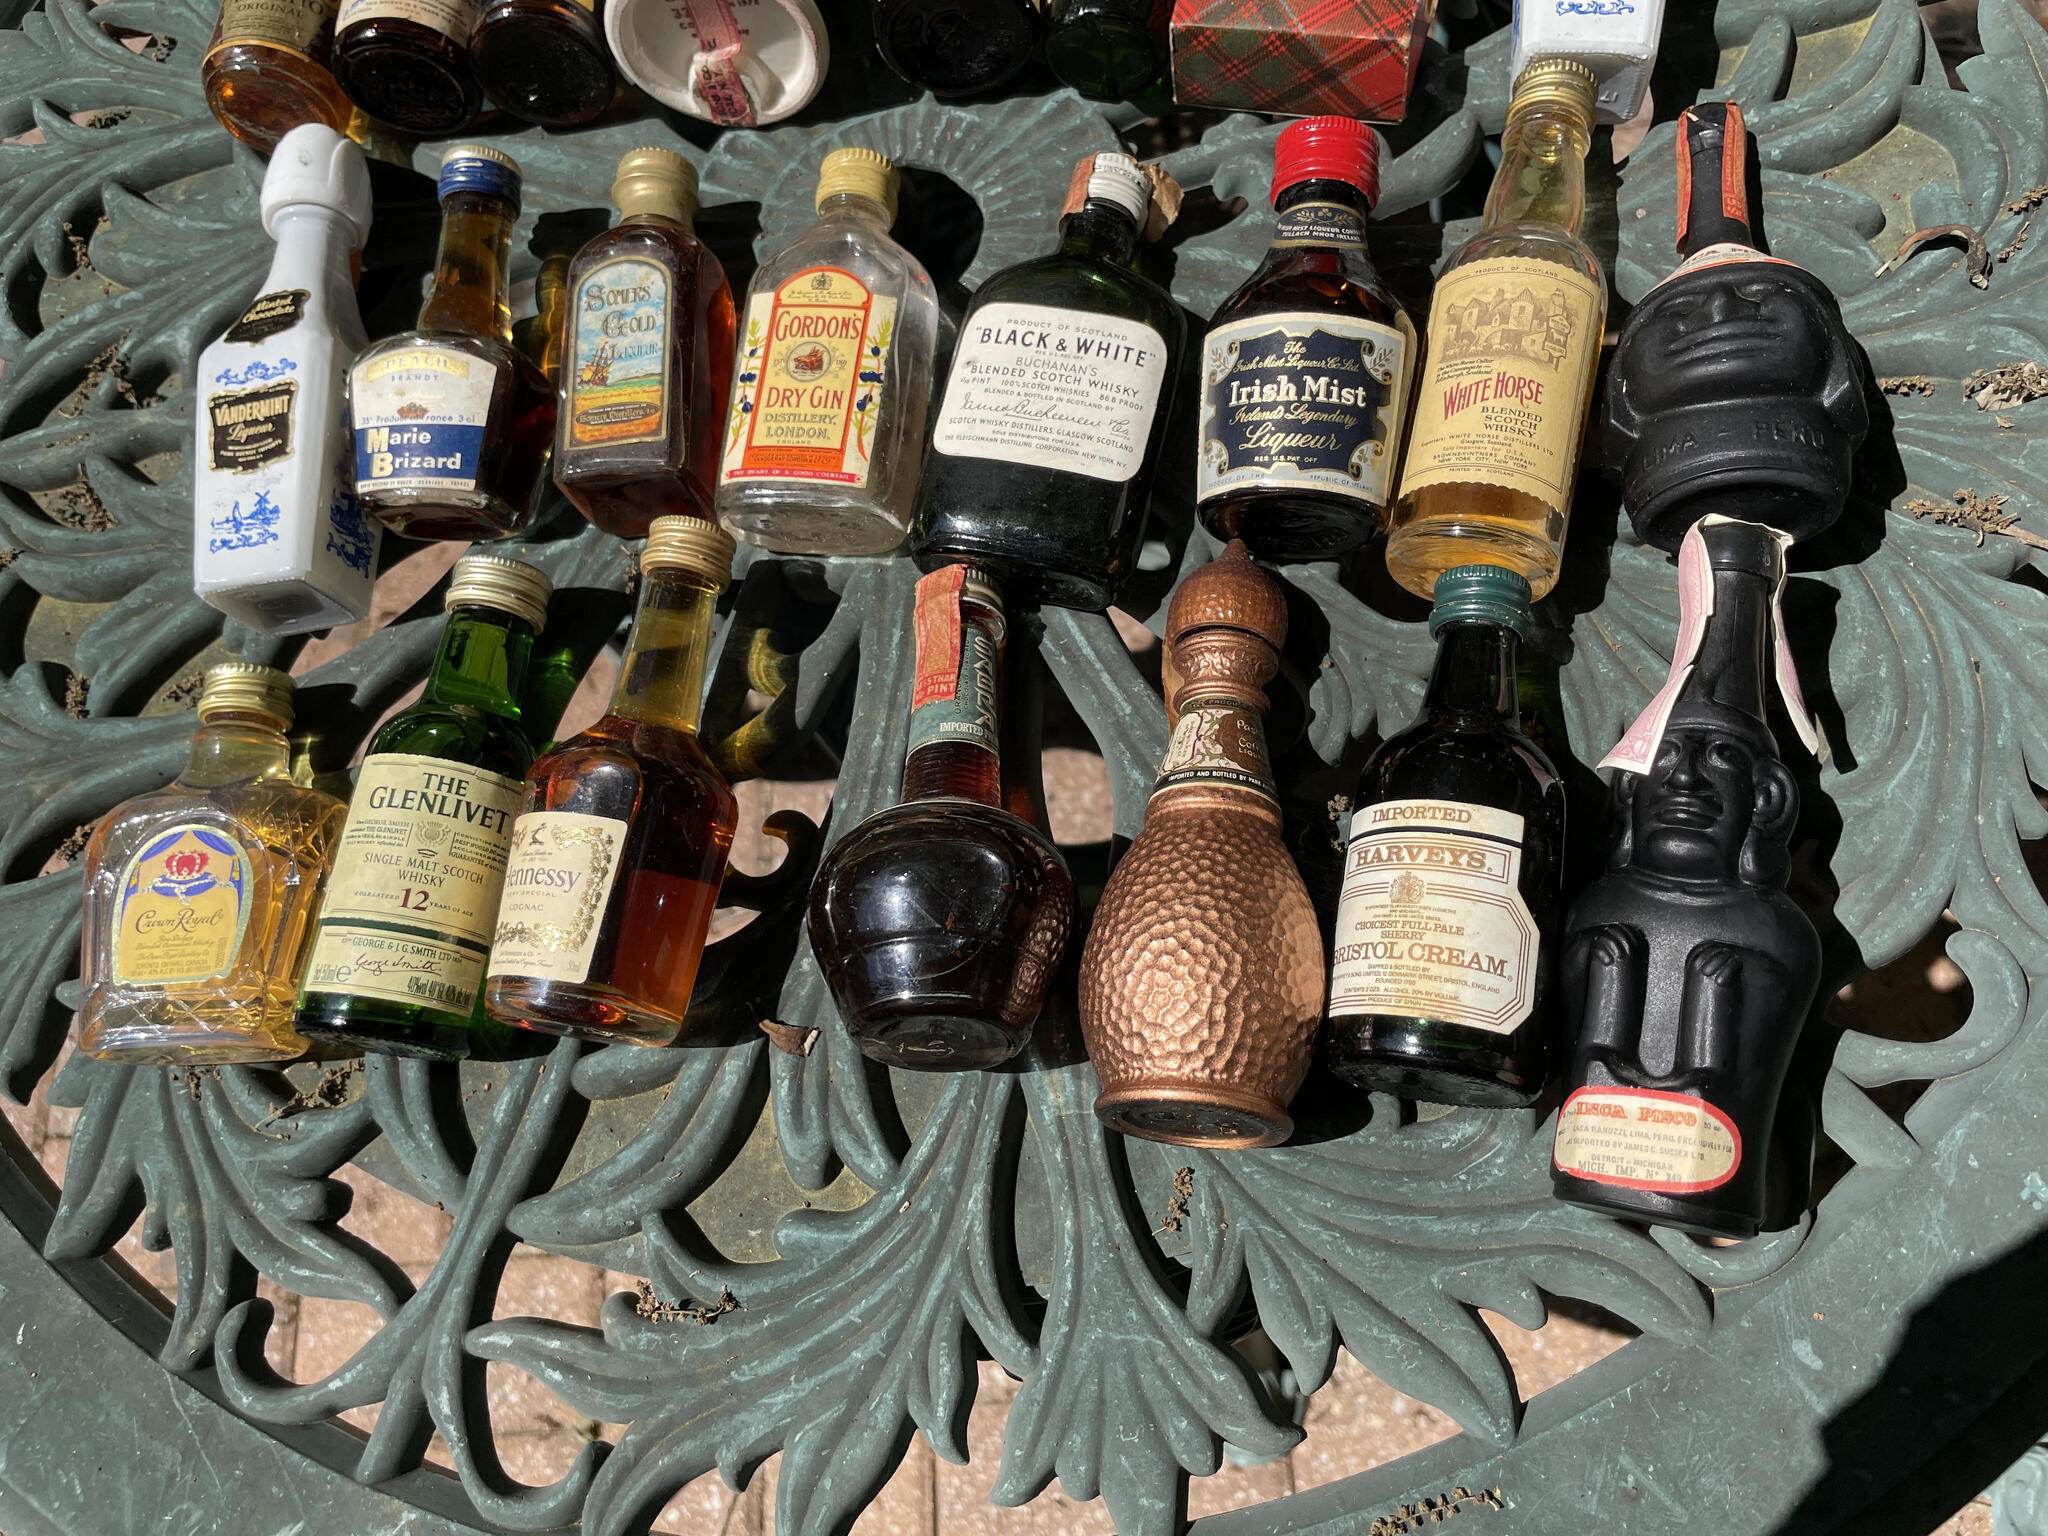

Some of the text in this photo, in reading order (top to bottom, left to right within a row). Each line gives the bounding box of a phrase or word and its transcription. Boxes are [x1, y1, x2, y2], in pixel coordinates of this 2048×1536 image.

[239, 2, 303, 17] ORIGINAL
[1309, 225, 1340, 233] LIQUEUR
[1475, 266, 1504, 274] PRODUCT
[1525, 267, 1558, 277] SCOTLAND
[603, 310, 656, 339] GOLD
[775, 310, 862, 341] GORDON'S
[1007, 319, 1052, 329] PRODUCT
[1075, 327, 1128, 342] SCOTLAND
[1056, 338, 1067, 352] &
[1283, 341, 1307, 354] The
[386, 356, 448, 369] PEACH
[1016, 356, 1098, 377] BUCHANAN'S
[1232, 354, 1327, 373] Irish Mist Liqueur
[391, 374, 440, 383] BRANDY
[971, 365, 1140, 398] BLENDED SCOTCH WHISKY
[765, 386, 844, 410] DRY GIN
[984, 388, 1015, 396] BLENDED
[1024, 390, 1054, 401] BOTTLED
[1066, 398, 1103, 410] SCOTLAND
[1022, 383, 1051, 392] SCOTCH
[1054, 386, 1090, 398] WHISKIES
[1119, 399, 1144, 412] PROOF
[1228, 374, 1367, 408] Irish Mist
[1443, 371, 1544, 421] WHITE HORSE
[215, 395, 290, 427] VANDERMINT
[458, 414, 476, 424] 3 cl
[1284, 402, 1359, 430] Legendary
[1481, 405, 1543, 423] BLENDED
[1484, 415, 1538, 431] SCOTCH
[1484, 423, 1537, 439] WHISKY
[366, 427, 432, 454] Marie
[948, 417, 977, 425] SCOTCH
[979, 418, 1009, 428] WHISKY
[1096, 437, 1134, 454] SCOTLAND
[1239, 421, 1342, 455] Liqueur
[1000, 438, 1033, 448] DISTILLING
[1035, 443, 1079, 456] CORPORATION
[1082, 451, 1097, 460] NEW
[1503, 436, 1540, 450] DISTILLERS
[1543, 447, 1554, 456] LTD
[371, 451, 462, 479] Brizard
[1504, 454, 1537, 468] COMPANY
[1512, 462, 1528, 470] YORK
[1310, 474, 1339, 485] REPUBLIC
[1486, 468, 1515, 477] SCOTLAND
[928, 673, 957, 685] THAN
[927, 682, 957, 695] PINT
[939, 721, 984, 736] IMPORTED
[422, 771, 470, 798] THE
[1168, 771, 1195, 782] IMPORTED
[1212, 771, 1237, 780] BOTTLED
[1239, 774, 1247, 782] BY
[1371, 806, 1472, 825] IMPORTED
[363, 852, 485, 885] SINGLE MALT SCOTCH
[398, 869, 447, 889] WHISKY
[399, 887, 431, 912] 12
[430, 901, 452, 911] YEARS
[462, 910, 474, 918] AGE
[520, 890, 557, 898] SPECIAL
[508, 903, 544, 912] COGNAC
[135, 907, 221, 935] Crown Royal
[1355, 920, 1465, 937] CHOICEST FULL PALE
[1380, 930, 1427, 941] SHERRY
[352, 937, 452, 961] GEORGE & SMITH LTD
[353, 953, 390, 976] George
[1394, 964, 1421, 972] BOTTLED
[1408, 942, 1508, 979] CREAM
[1375, 977, 1403, 985] FOUNDED
[1471, 981, 1500, 994] ENGLAND
[1367, 996, 1422, 1007] PRODUCE SPAIN
[1434, 991, 1460, 1000] VOLUME
[1576, 1101, 1629, 1119] INCA
[1637, 1107, 1697, 1127] PISCO
[1612, 1141, 1623, 1149] BY
[1624, 1142, 1649, 1153] JAMES
[1591, 1153, 1673, 1171] DETROIT MICHIGAN
